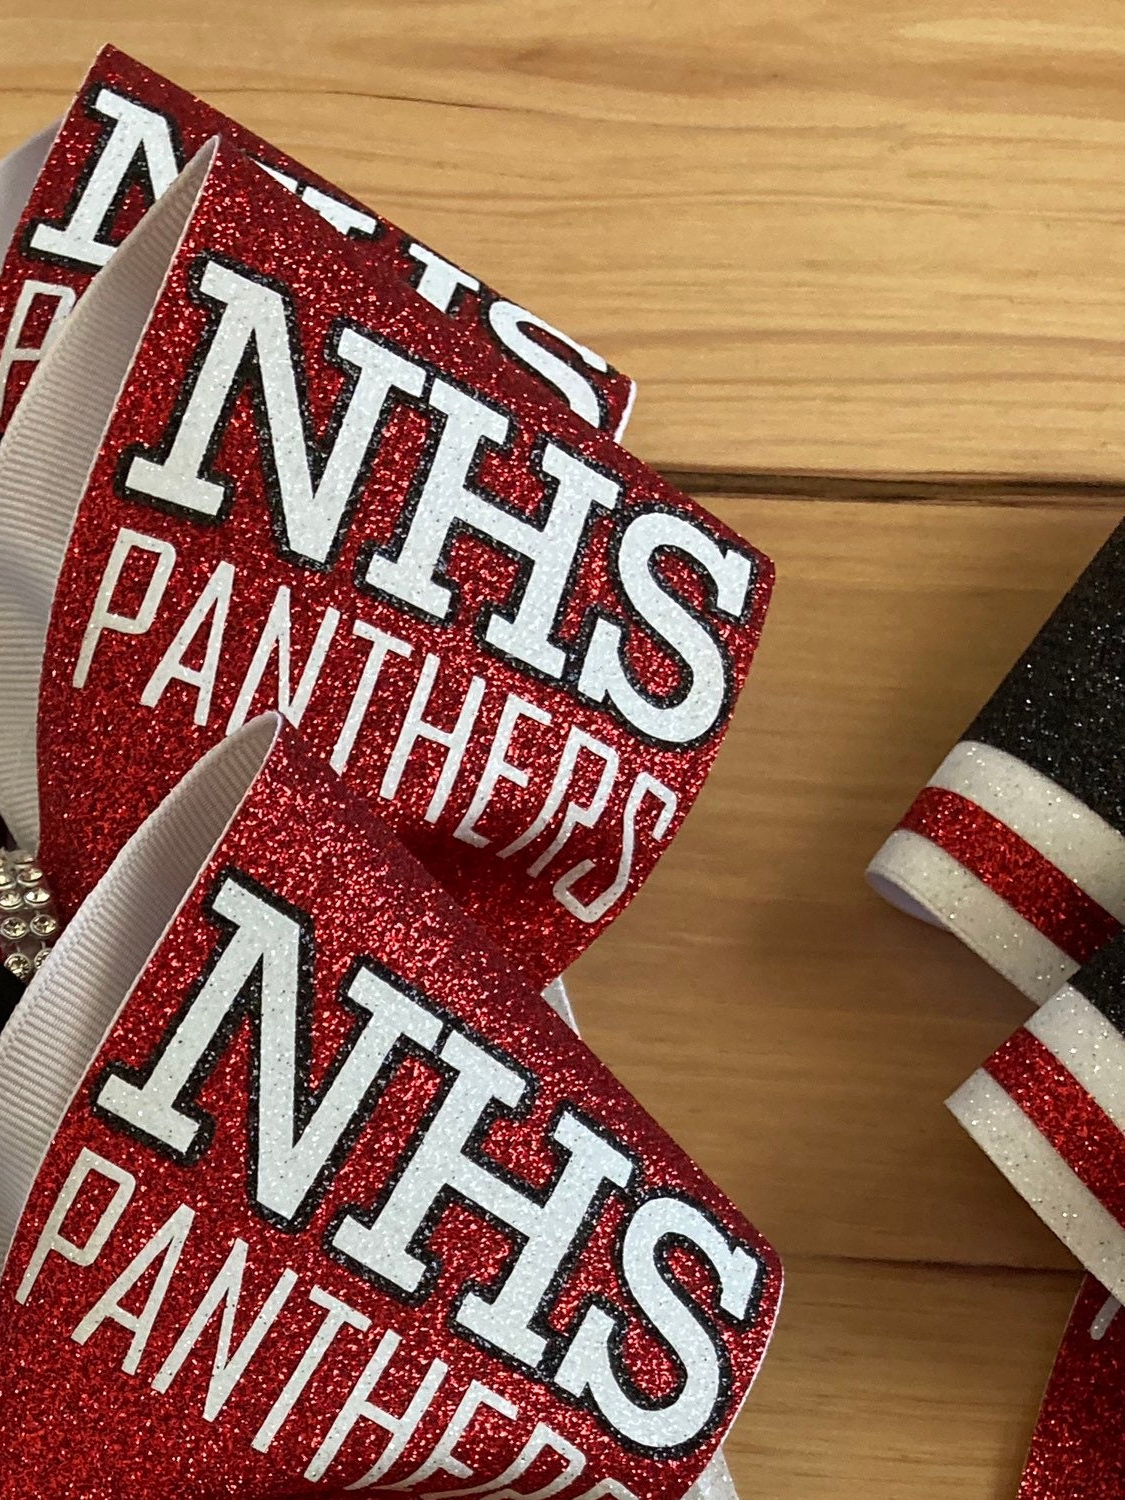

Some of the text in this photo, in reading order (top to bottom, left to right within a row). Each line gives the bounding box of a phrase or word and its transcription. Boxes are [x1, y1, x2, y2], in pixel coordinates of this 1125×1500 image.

[72, 527, 678, 924] PANTHERS
[120, 254, 757, 748] NHS
[92, 871, 767, 1460] NHS
